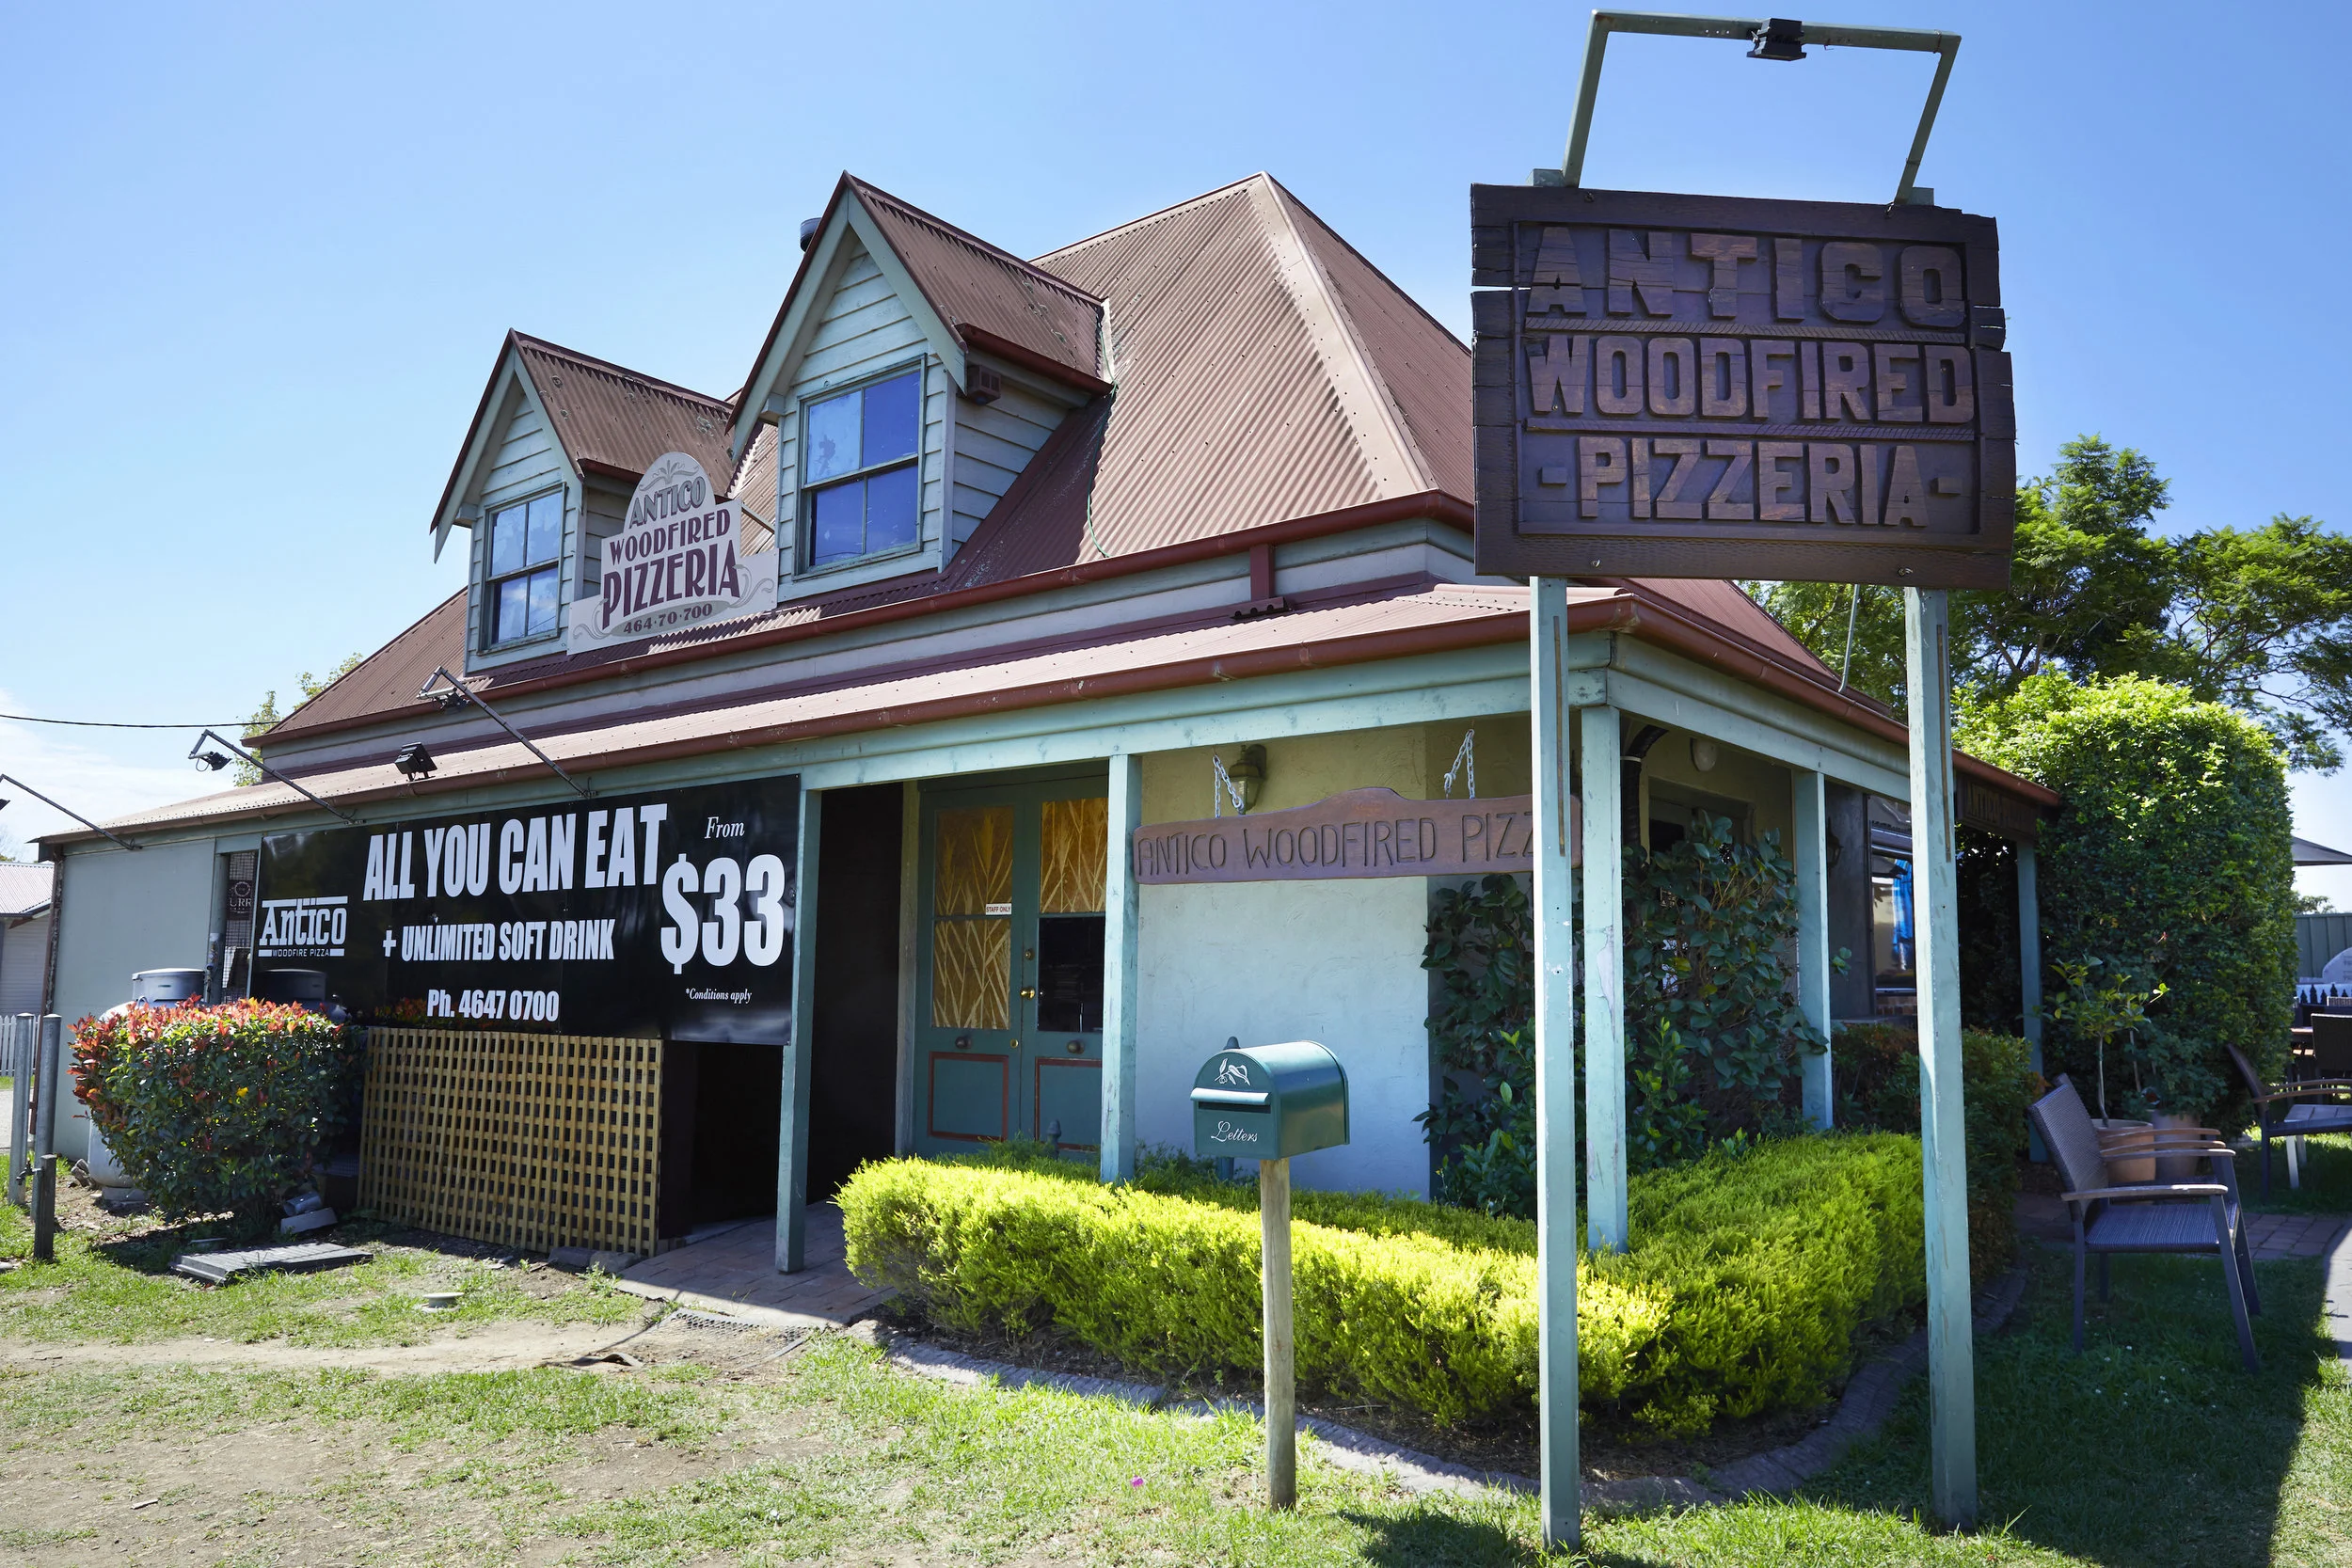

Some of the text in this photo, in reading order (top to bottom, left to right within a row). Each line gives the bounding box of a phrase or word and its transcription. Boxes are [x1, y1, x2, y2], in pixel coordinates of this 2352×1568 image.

[1527, 226, 1966, 328] ANTICO
[1526, 334, 1974, 423] WOODFIRED
[628, 475, 706, 529] ANTICO
[610, 508, 731, 565] WOODFIRED
[602, 539, 740, 630] PIZZERIA
[362, 803, 668, 901] ALL YOU CAN EAT
[705, 816, 745, 839] From
[1137, 832, 1227, 877] ANTICO
[1243, 817, 1437, 870] WOODFIRED
[401, 923, 496, 961] UNLIMITED
[499, 921, 547, 961] SOFT
[548, 918, 616, 960] DRINK
[660, 853, 786, 974] $33
[272, 948, 330, 958] WOODFIRE PIZZA
[426, 989, 560, 1022] Ph. 4647 0700
[730, 990, 753, 1005] apply
[1211, 1120, 1258, 1143] Letters
